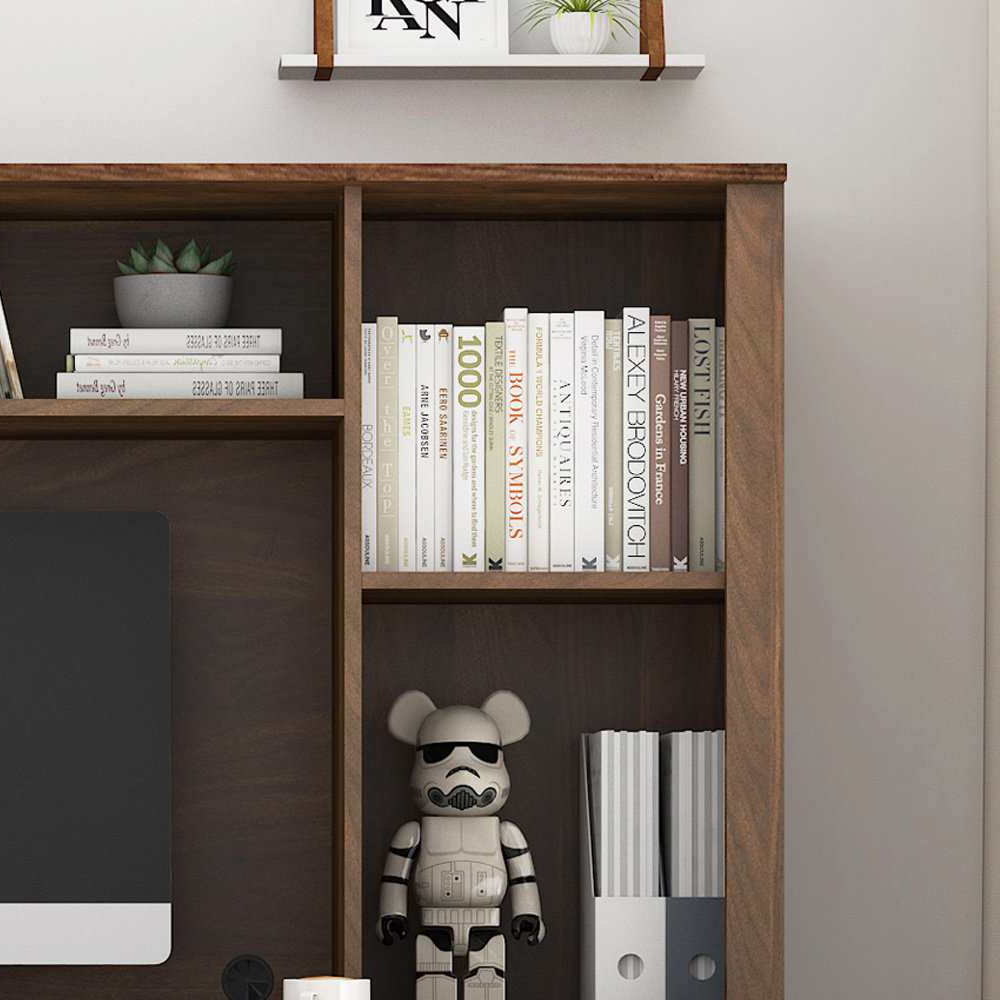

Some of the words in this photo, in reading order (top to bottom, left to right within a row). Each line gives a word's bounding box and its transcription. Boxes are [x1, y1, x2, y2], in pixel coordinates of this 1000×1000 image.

[458, 335, 482, 408] 1000
[627, 314, 646, 403] ALEXEY
[694, 326, 711, 382] LOST
[403, 406, 411, 437] EAMES
[439, 388, 447, 411] EERO
[509, 373, 523, 425] BOOK
[655, 393, 666, 444] Gardens
[694, 389, 711, 436] FISH
[362, 424, 373, 488] BORDEAUX
[439, 413, 447, 459] SAARINEN
[557, 380, 571, 508] ANTIQUAIRES
[655, 447, 666, 459] in
[509, 445, 523, 539] SYMBOLS
[627, 410, 646, 558] BRODOVITCH
[655, 463, 666, 505] France
